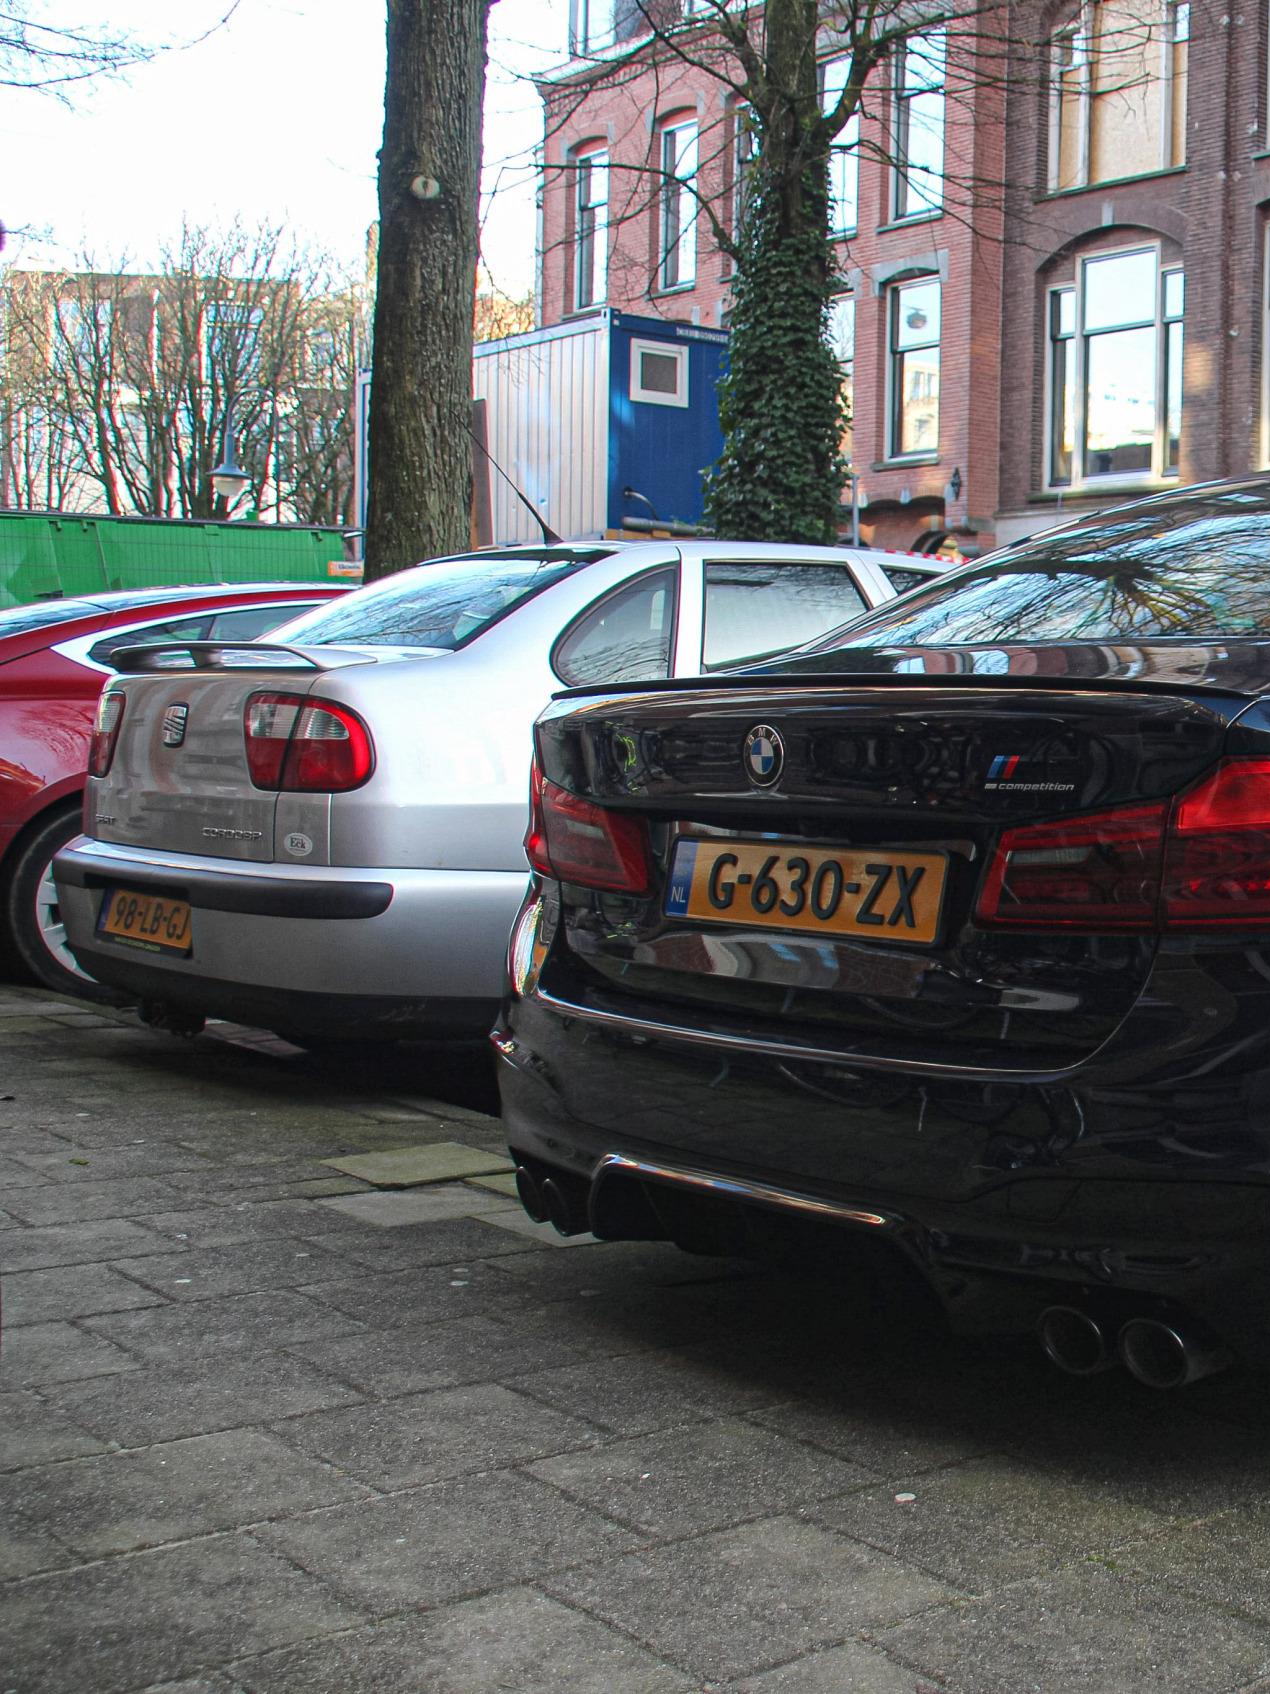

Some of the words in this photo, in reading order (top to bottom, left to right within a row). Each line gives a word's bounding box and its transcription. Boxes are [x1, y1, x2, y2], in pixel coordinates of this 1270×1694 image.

[747, 727, 779, 746] BMW
[998, 782, 1075, 791] competition
[671, 885, 687, 903] NL
[708, 852, 926, 928] G-630-ZX
[113, 896, 190, 940] 98-LB-GJ
